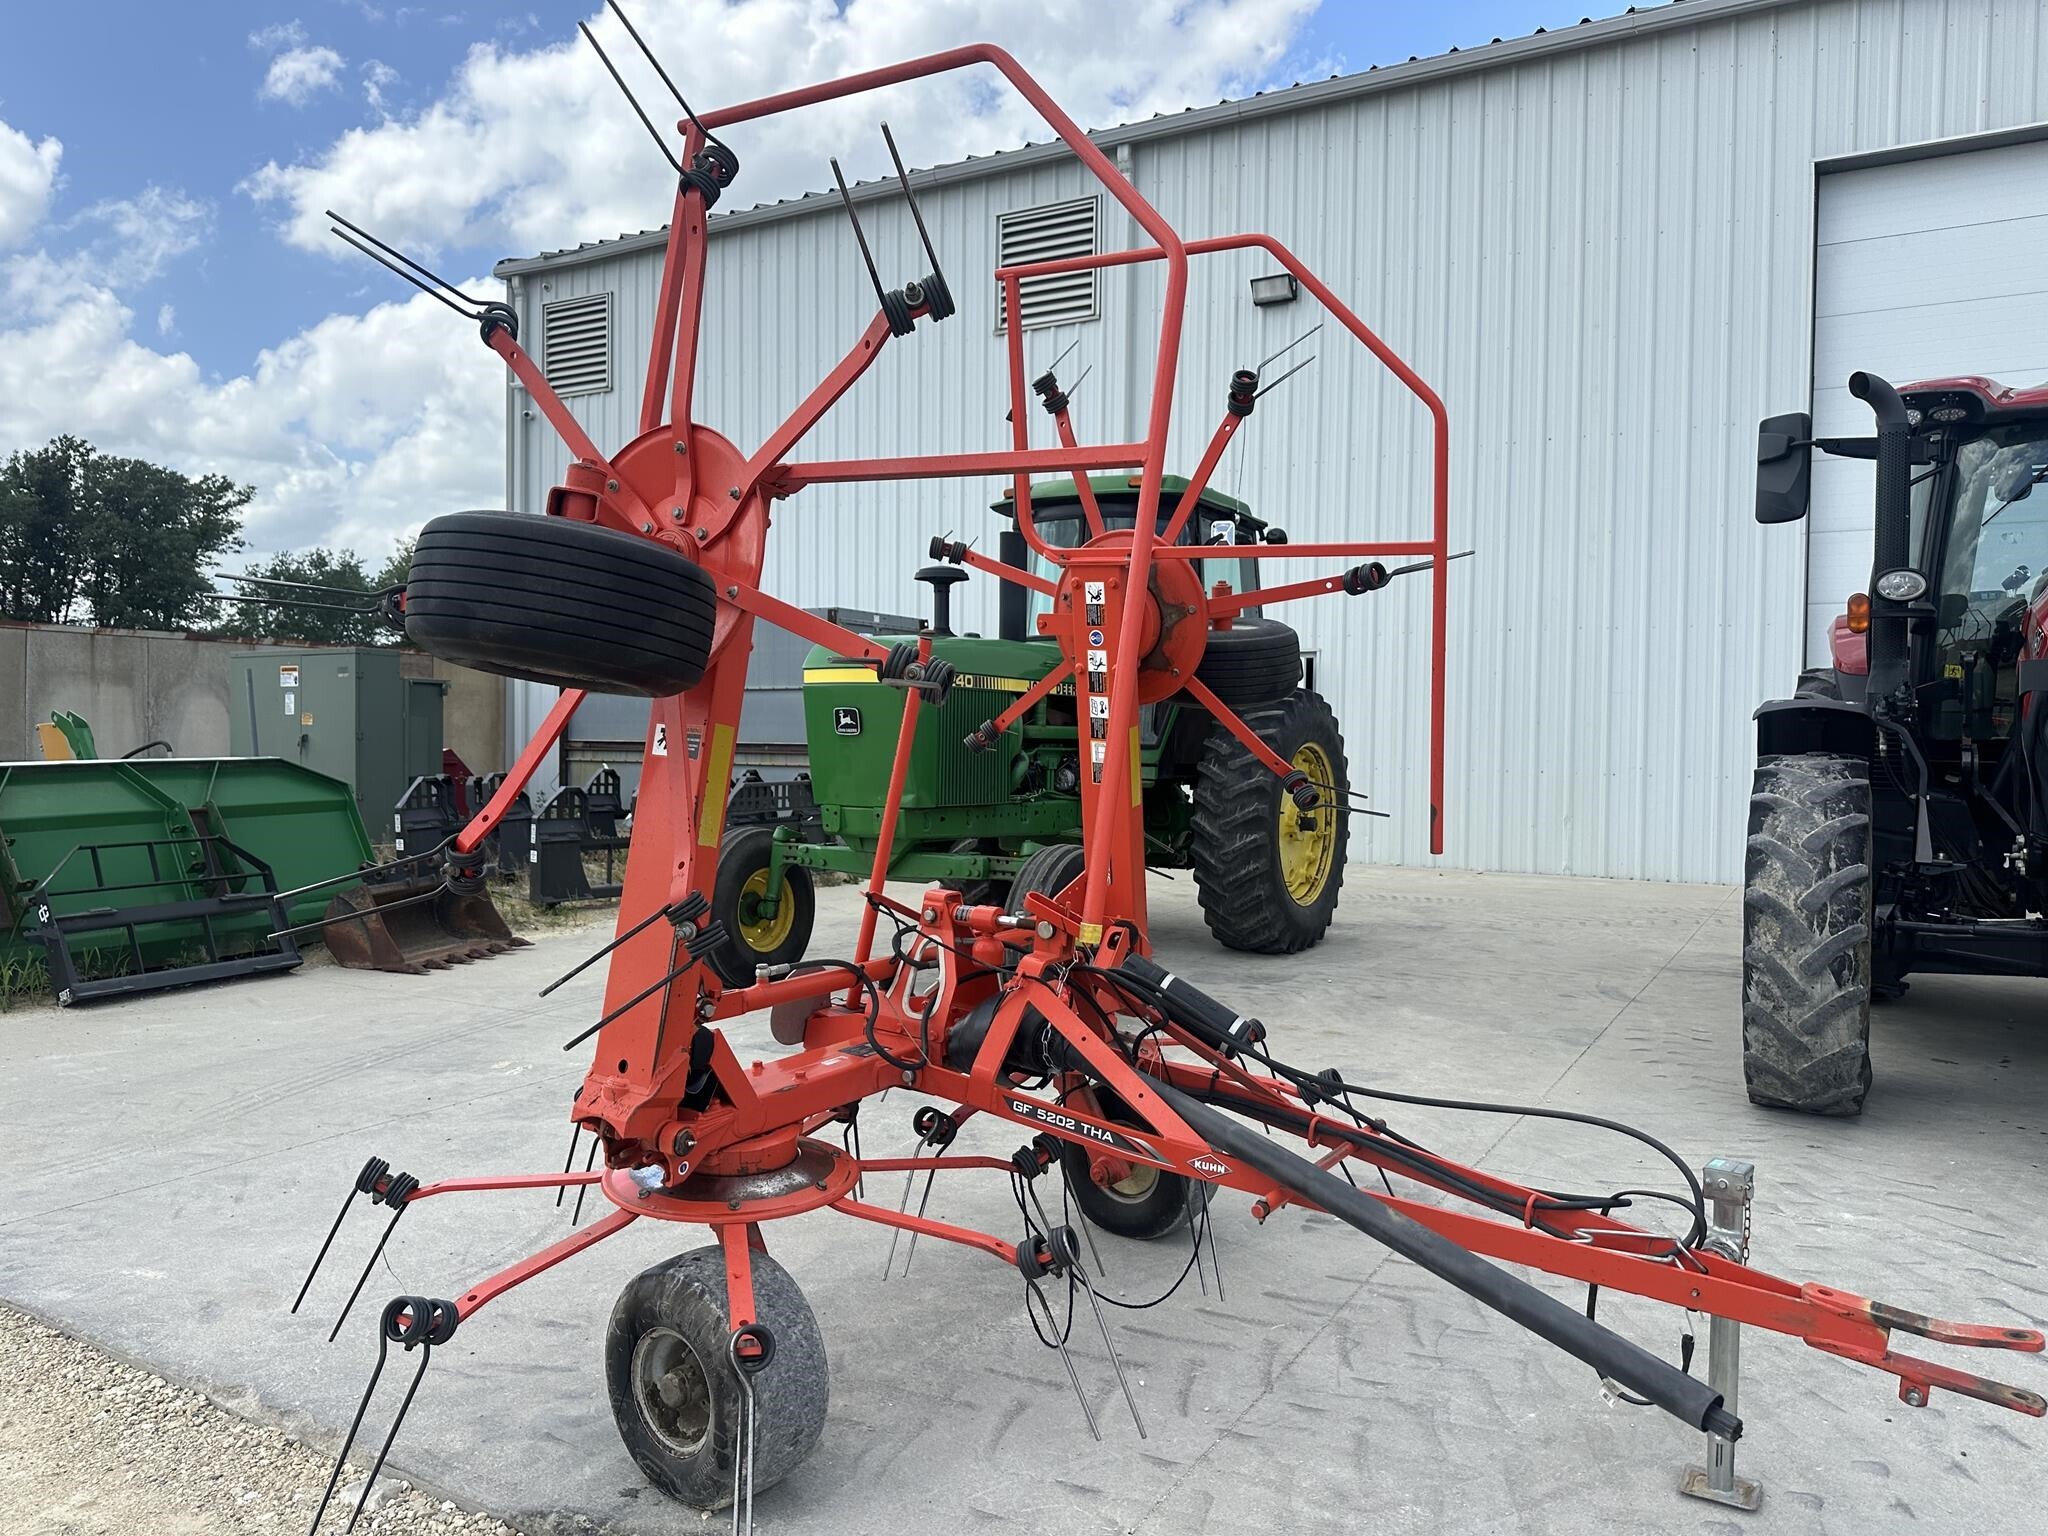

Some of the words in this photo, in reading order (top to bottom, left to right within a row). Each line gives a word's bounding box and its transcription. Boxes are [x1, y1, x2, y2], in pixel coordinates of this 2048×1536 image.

[1012, 1101, 1033, 1115] GF
[1037, 1109, 1076, 1130] 5202
[1080, 1122, 1114, 1143] THA
[1194, 1160, 1226, 1174] KUHN
